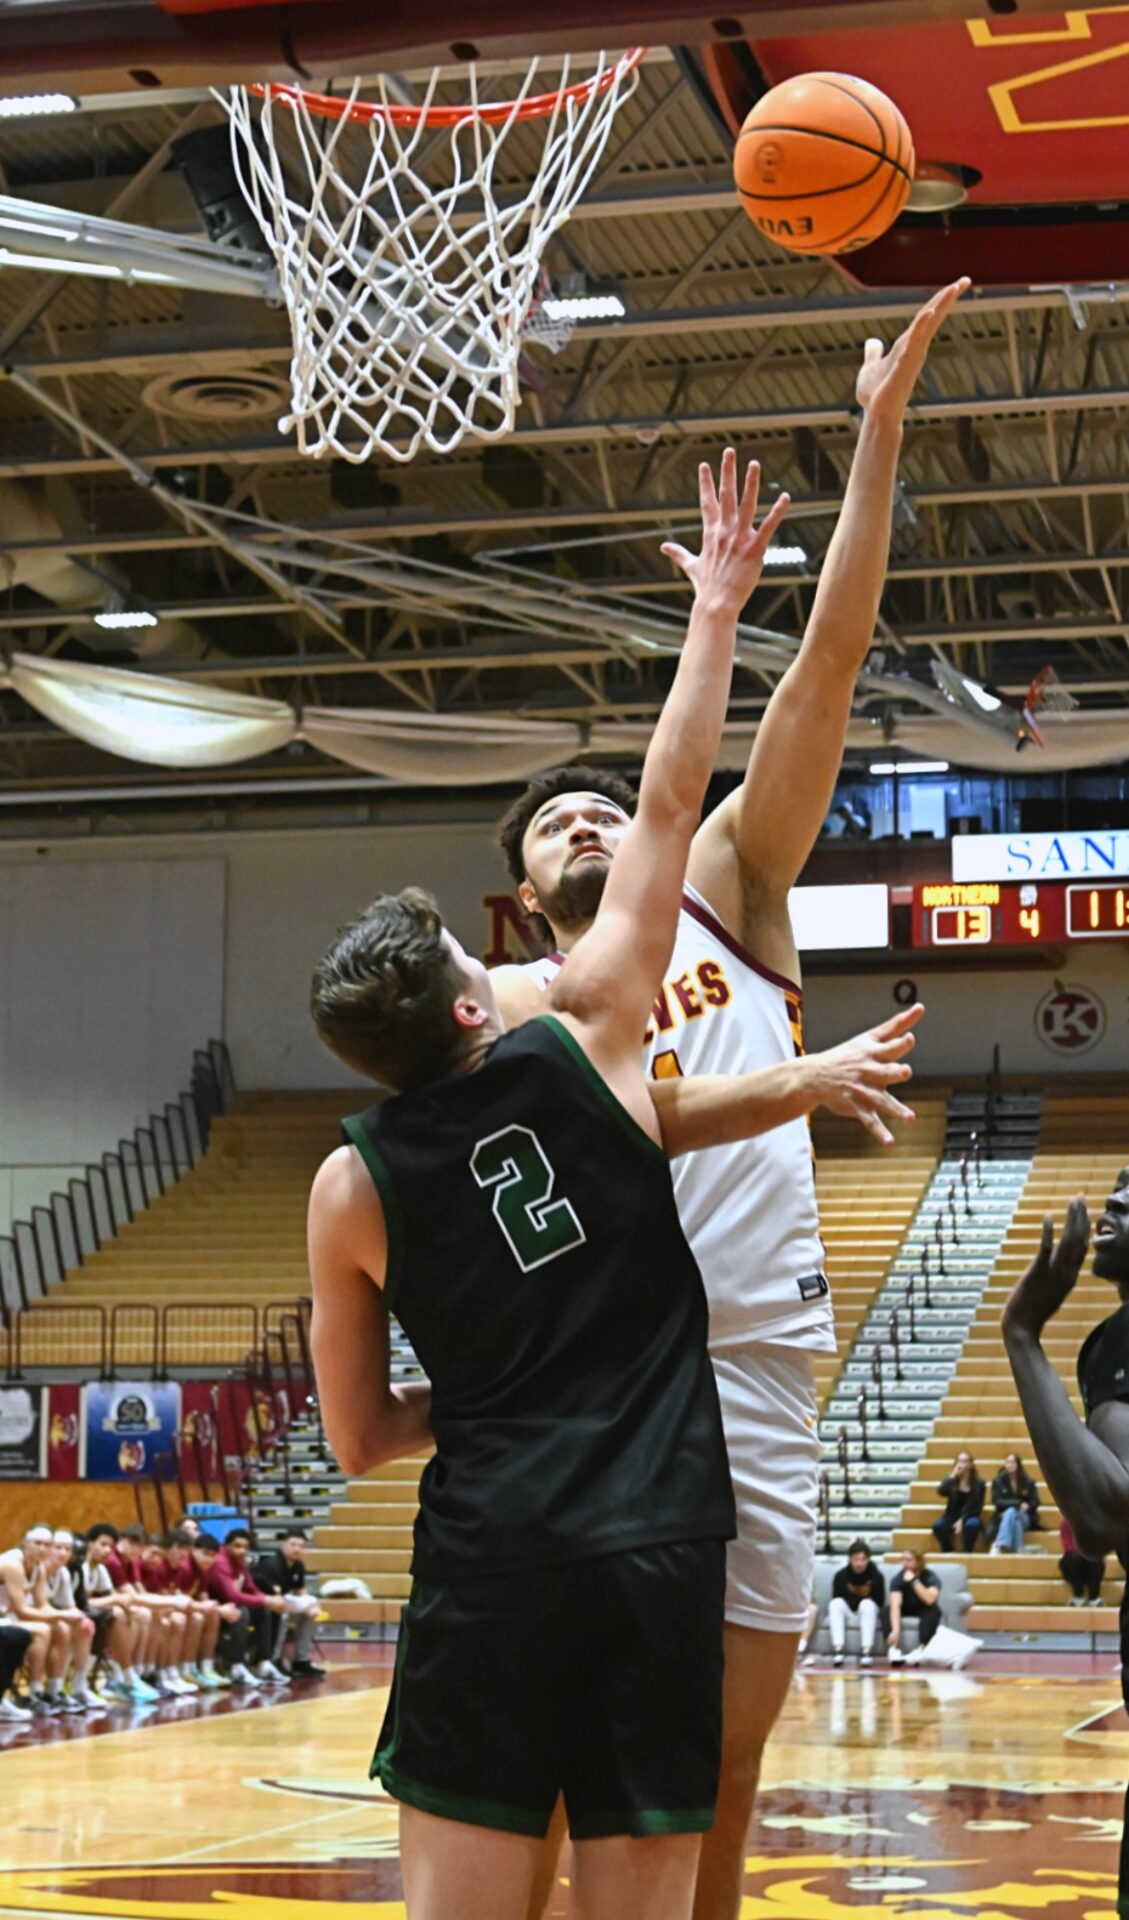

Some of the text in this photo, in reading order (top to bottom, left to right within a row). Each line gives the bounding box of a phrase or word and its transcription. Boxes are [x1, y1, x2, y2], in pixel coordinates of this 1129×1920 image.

[1007, 835, 1129, 874] SAN
[957, 908, 989, 941] 13
[1019, 908, 1040, 938] 4
[643, 959, 733, 1045] VES
[1046, 1003, 1096, 1038] K
[469, 1123, 587, 1274] 2
